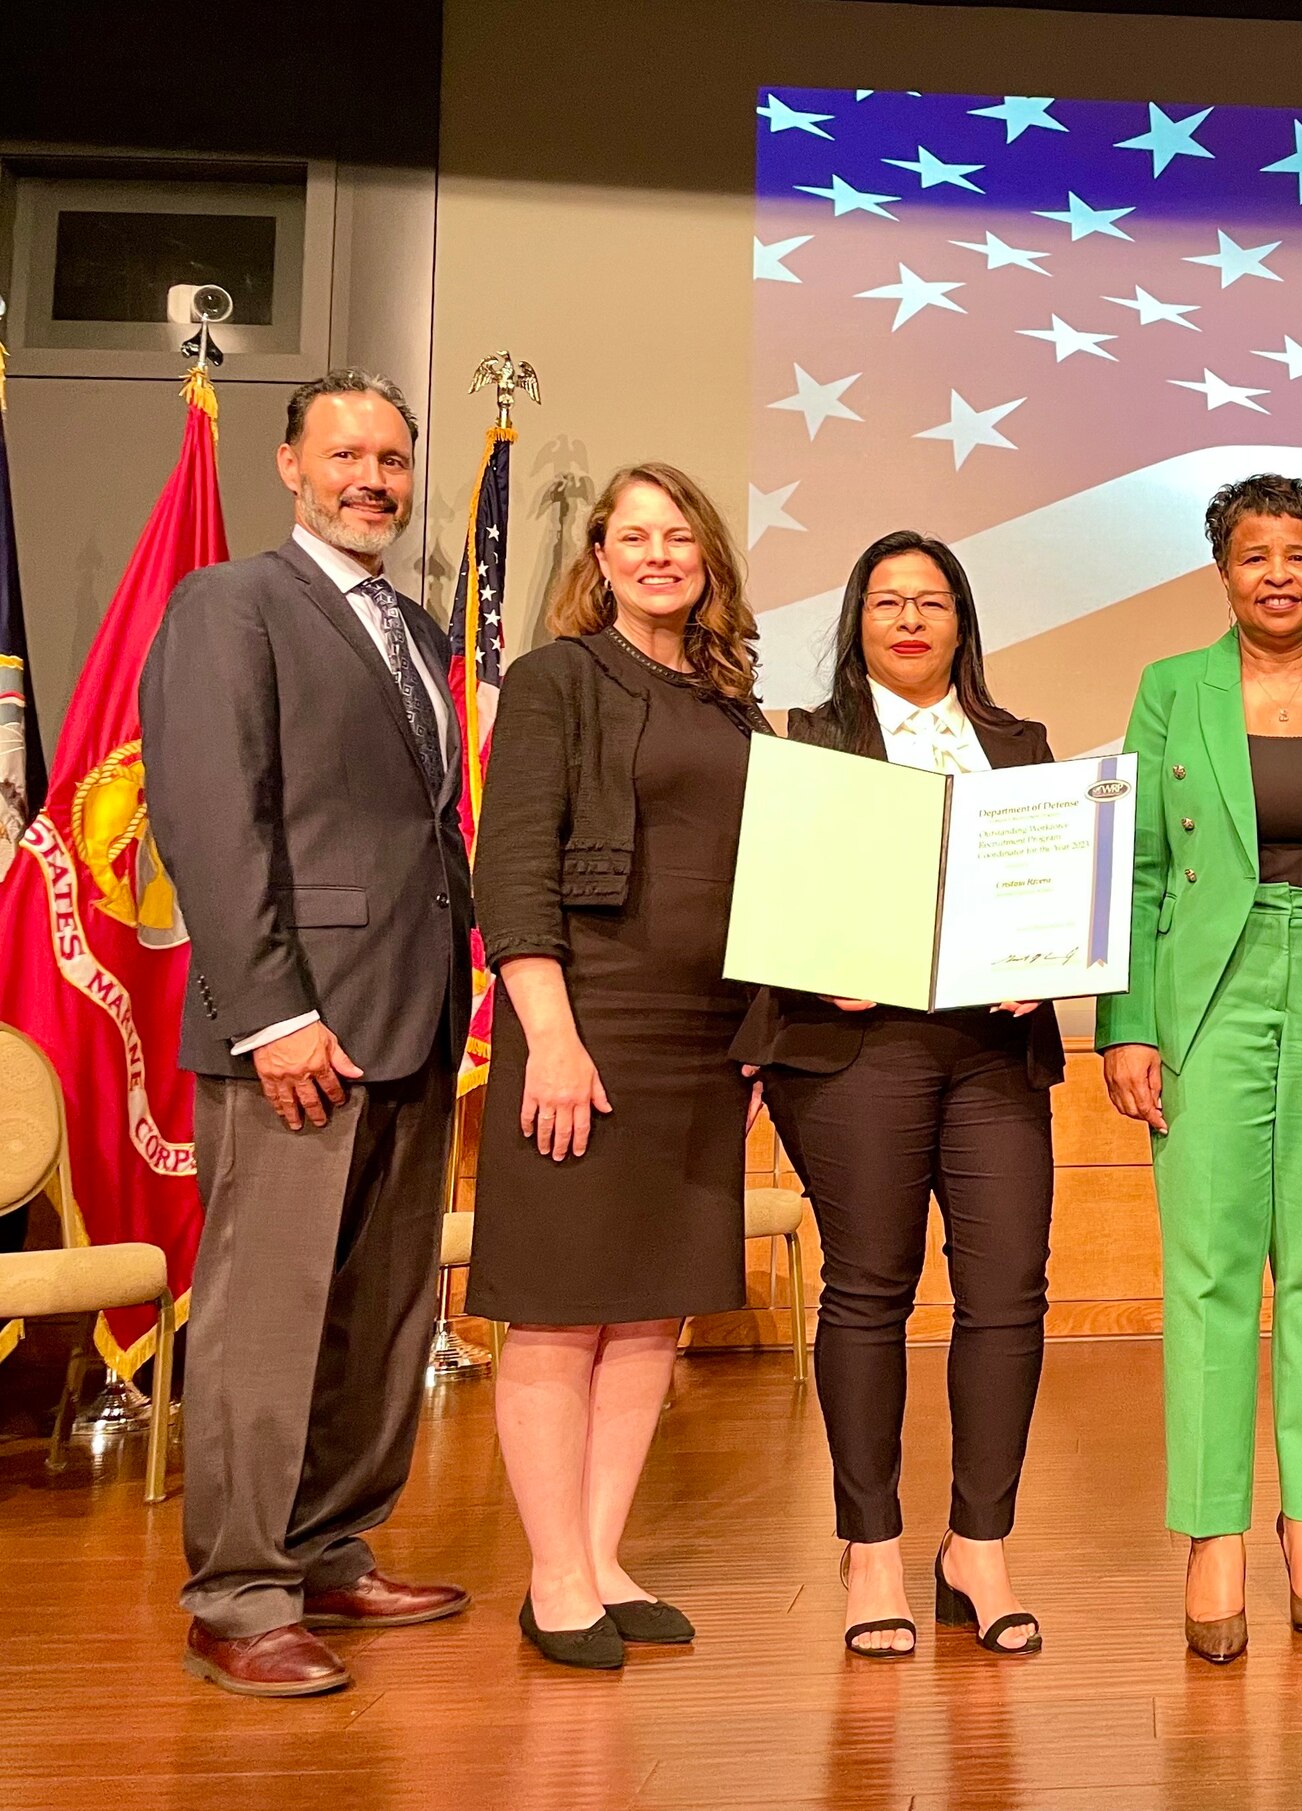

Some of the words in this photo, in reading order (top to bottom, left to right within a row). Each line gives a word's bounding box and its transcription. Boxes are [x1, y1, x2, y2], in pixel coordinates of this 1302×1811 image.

[978, 804, 1030, 819] Department
[1031, 802, 1042, 811] of
[1043, 800, 1080, 810] Defense
[24, 818, 85, 960] STATES
[135, 1117, 197, 1173] CORP
